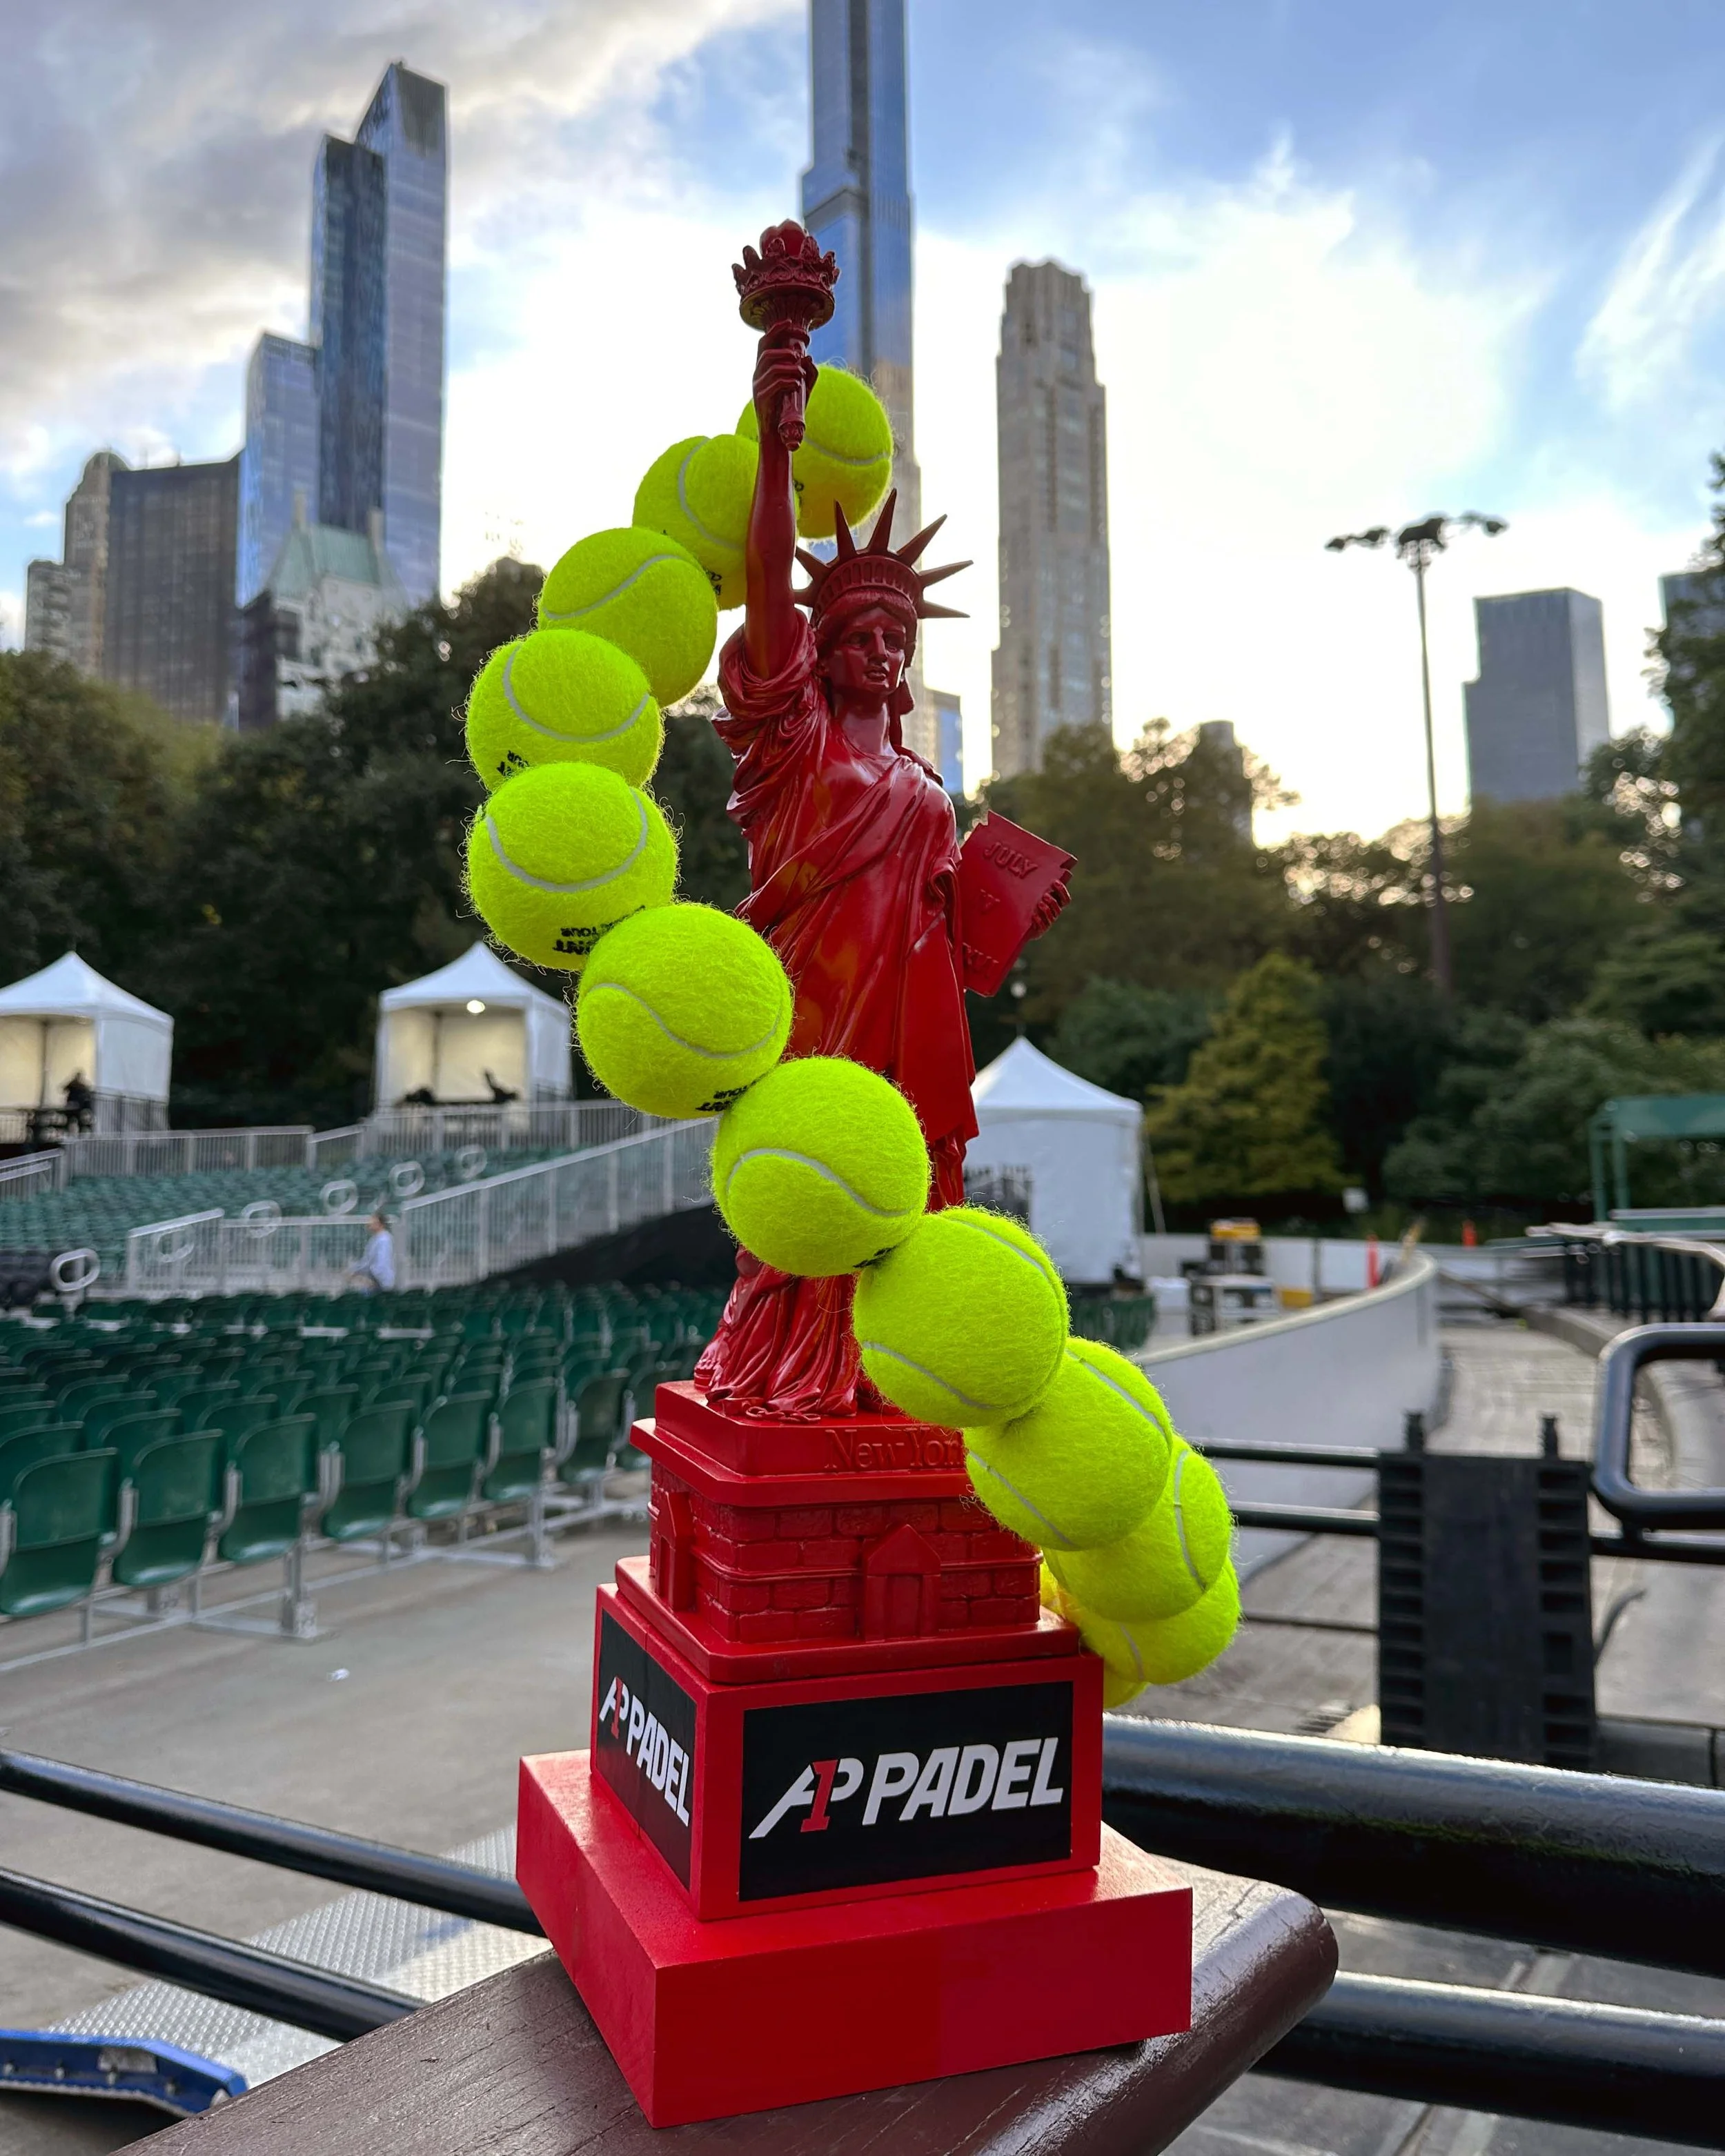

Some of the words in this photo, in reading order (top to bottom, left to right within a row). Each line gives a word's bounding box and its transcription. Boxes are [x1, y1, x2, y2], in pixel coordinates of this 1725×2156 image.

[983, 841, 1038, 879] JULY
[824, 1429, 905, 1470] New
[903, 1426, 963, 1467] Yor
[626, 1694, 690, 1827] PADEL
[861, 1737, 1064, 1826] PADEL
